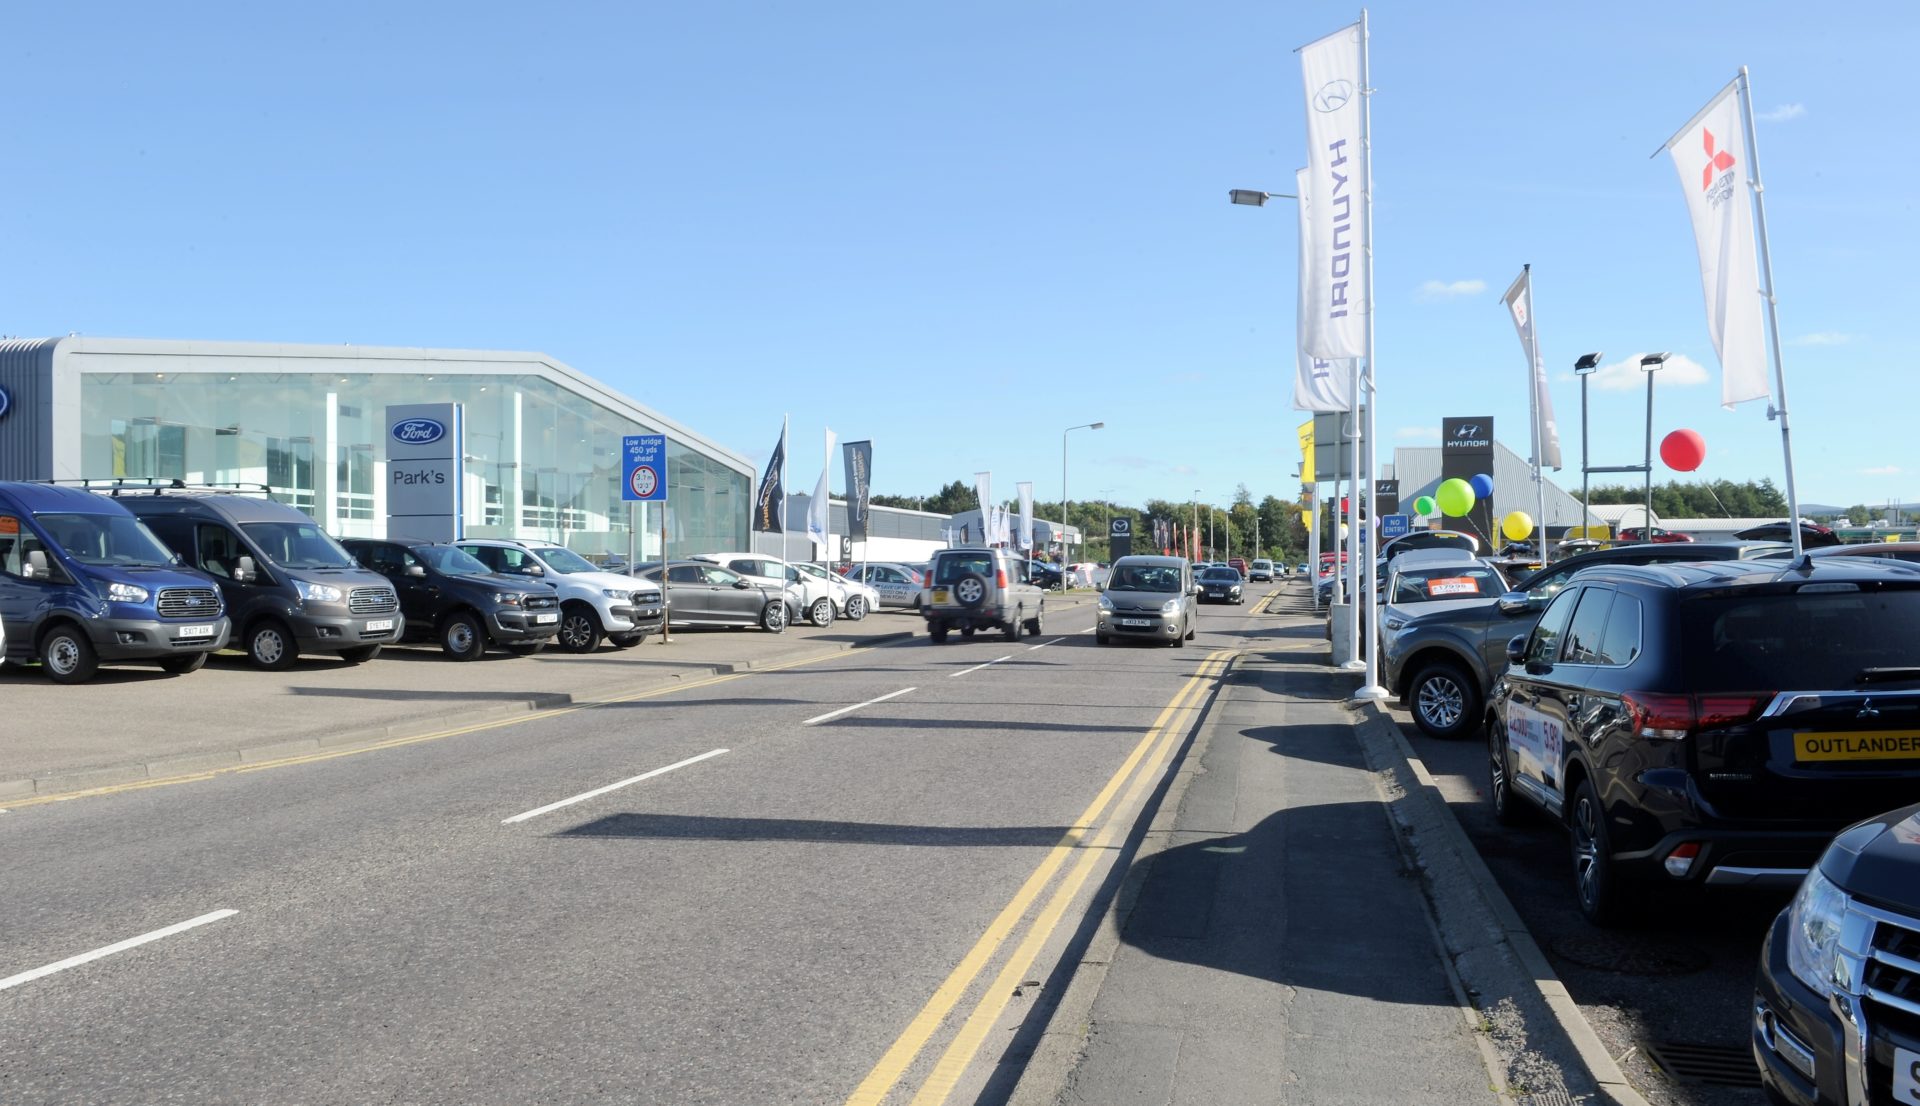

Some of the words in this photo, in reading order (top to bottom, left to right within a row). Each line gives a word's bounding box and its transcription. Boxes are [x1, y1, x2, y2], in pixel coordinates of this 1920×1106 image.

[401, 422, 433, 439] Ford
[625, 438, 639, 446] Low
[641, 438, 662, 446] bridge
[1447, 440, 1489, 448] HYUNDAI
[630, 446, 644, 454] 450
[646, 446, 658, 454] yds
[393, 470, 445, 485] Park's
[1384, 525, 1406, 533] ENTRY
[1805, 737, 1920, 754] OUTLANDER
